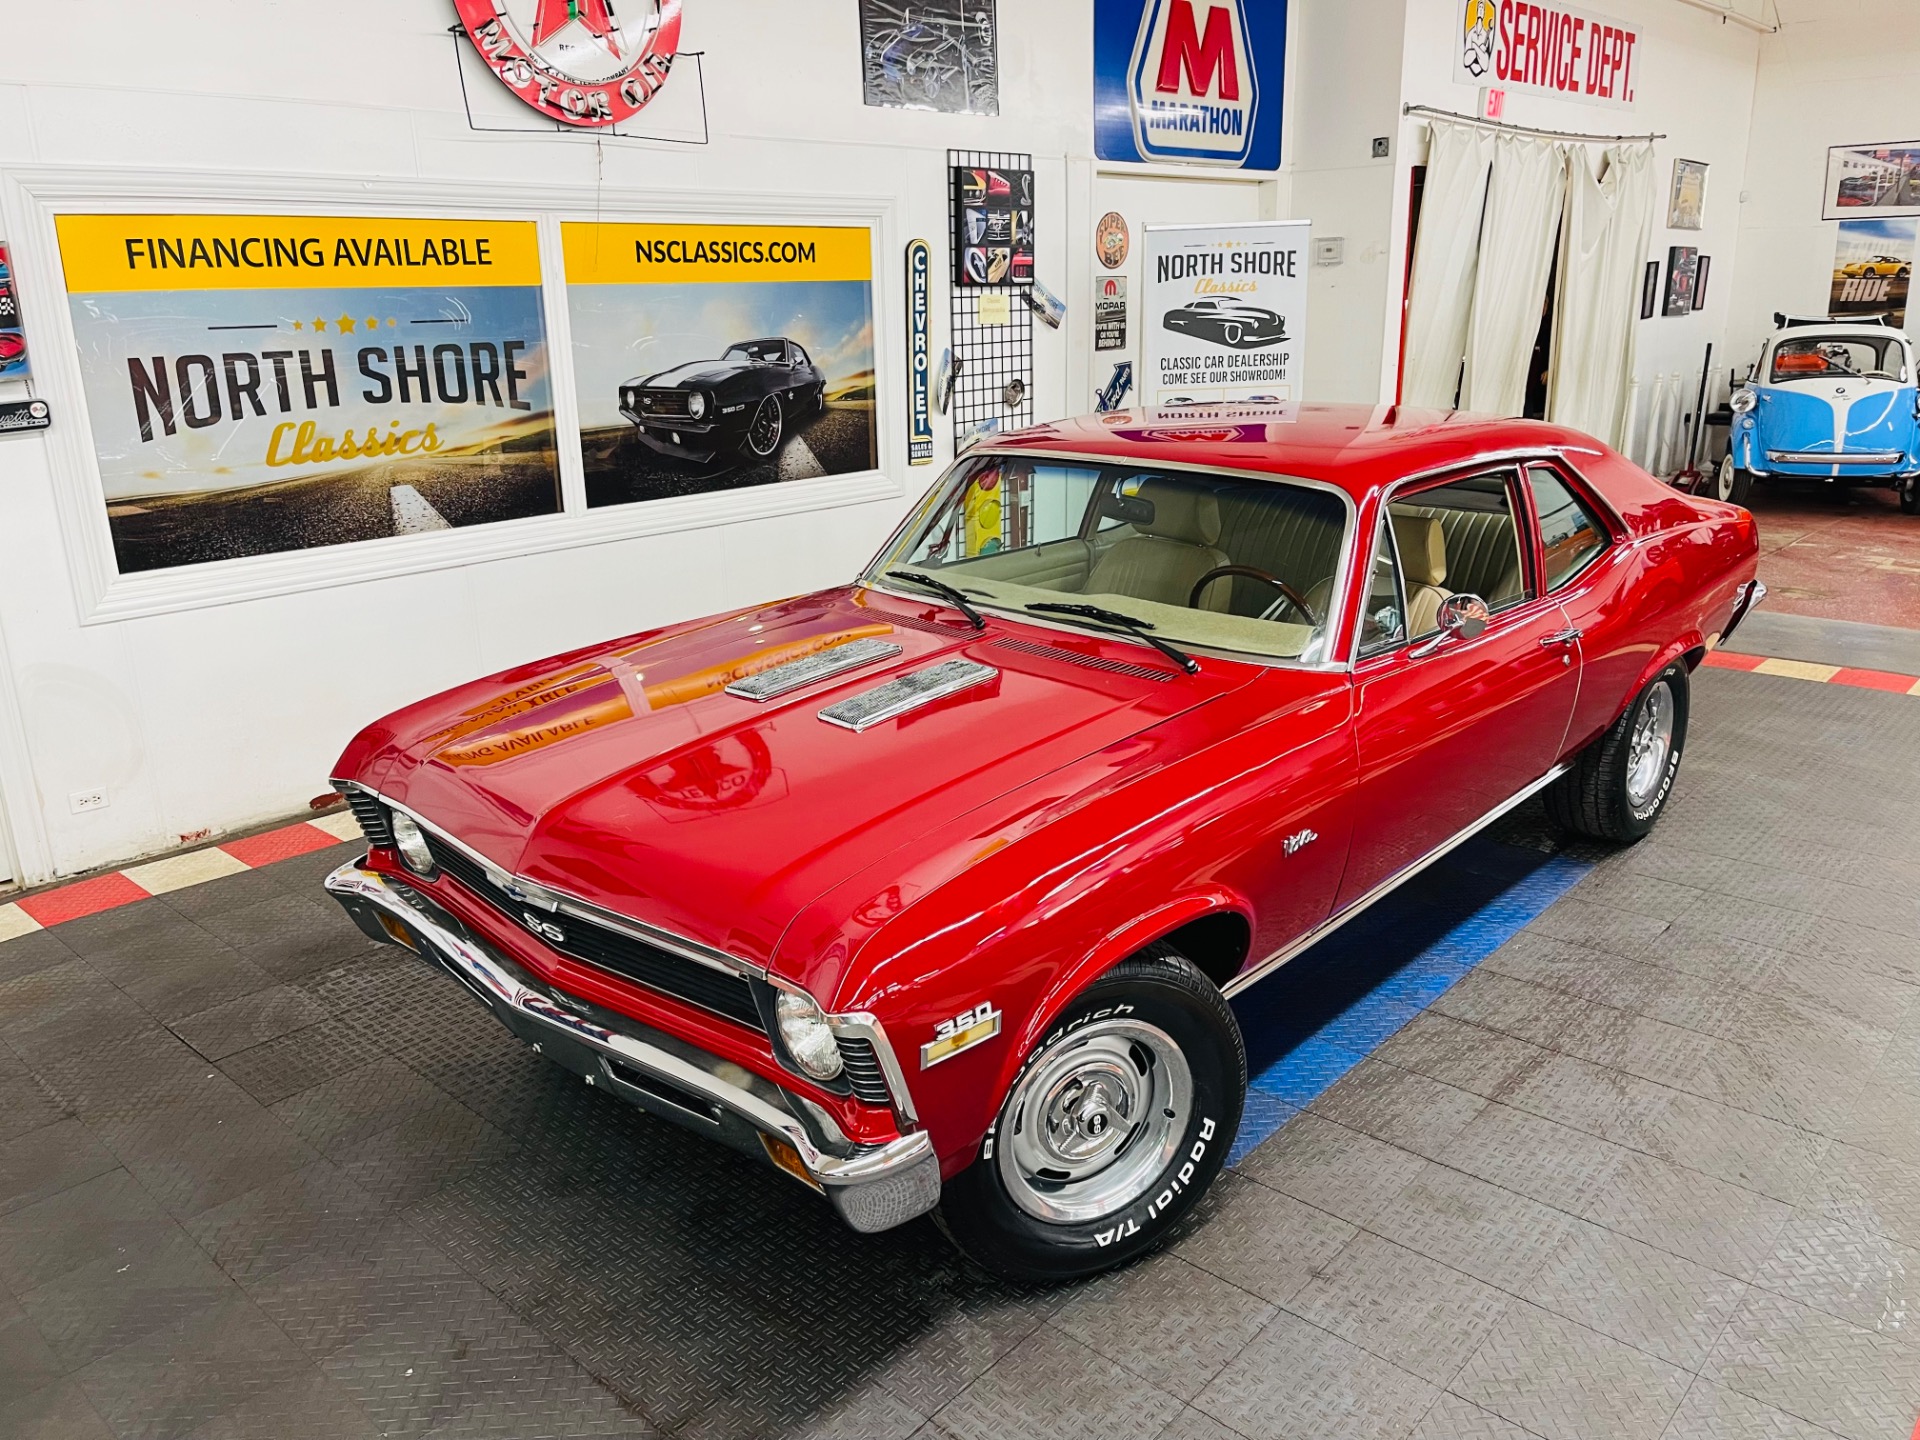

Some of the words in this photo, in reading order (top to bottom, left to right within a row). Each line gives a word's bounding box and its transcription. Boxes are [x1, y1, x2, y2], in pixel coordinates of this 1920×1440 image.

[1496, 0, 1584, 92] SERVICE
[1586, 22, 1636, 102] DEPT.
[474, 17, 614, 122] MOTOR
[1150, 100, 1242, 136] MARATHON
[1487, 88, 1505, 118] EXIT
[1099, 214, 1126, 244] SUPER
[125, 238, 324, 269] FINANCING
[333, 238, 492, 267] AVAILABLE
[635, 240, 817, 264] NSCLASSICS.COM
[1103, 246, 1125, 266] BEE
[1157, 252, 1224, 284] NORTH
[1230, 250, 1297, 278] SHORE
[1194, 278, 1258, 294] Classics
[1839, 278, 1892, 302] RIDE
[1095, 301, 1126, 311] MOPAR
[914, 251, 928, 433] CHEVROLET
[1160, 356, 1201, 371] CLASSIC
[1204, 355, 1224, 369] CAR
[1227, 353, 1290, 368] DEALERSHIP
[1162, 372, 1188, 385] COME
[1190, 372, 1207, 383] SEE
[1209, 371, 1228, 382] OUR
[1230, 368, 1286, 382] SHOWROOM!
[126, 349, 339, 443] NORTH
[356, 340, 532, 411] SHORE
[266, 420, 445, 468] Classics
[911, 443, 927, 451] SALES
[911, 450, 933, 458] SERVICE
[1633, 750, 1679, 821] BFGoodrich
[523, 912, 564, 942] SS
[933, 1000, 993, 1042] 350
[1148, 1116, 1216, 1220] Radial
[1094, 1222, 1141, 1247] T/A
